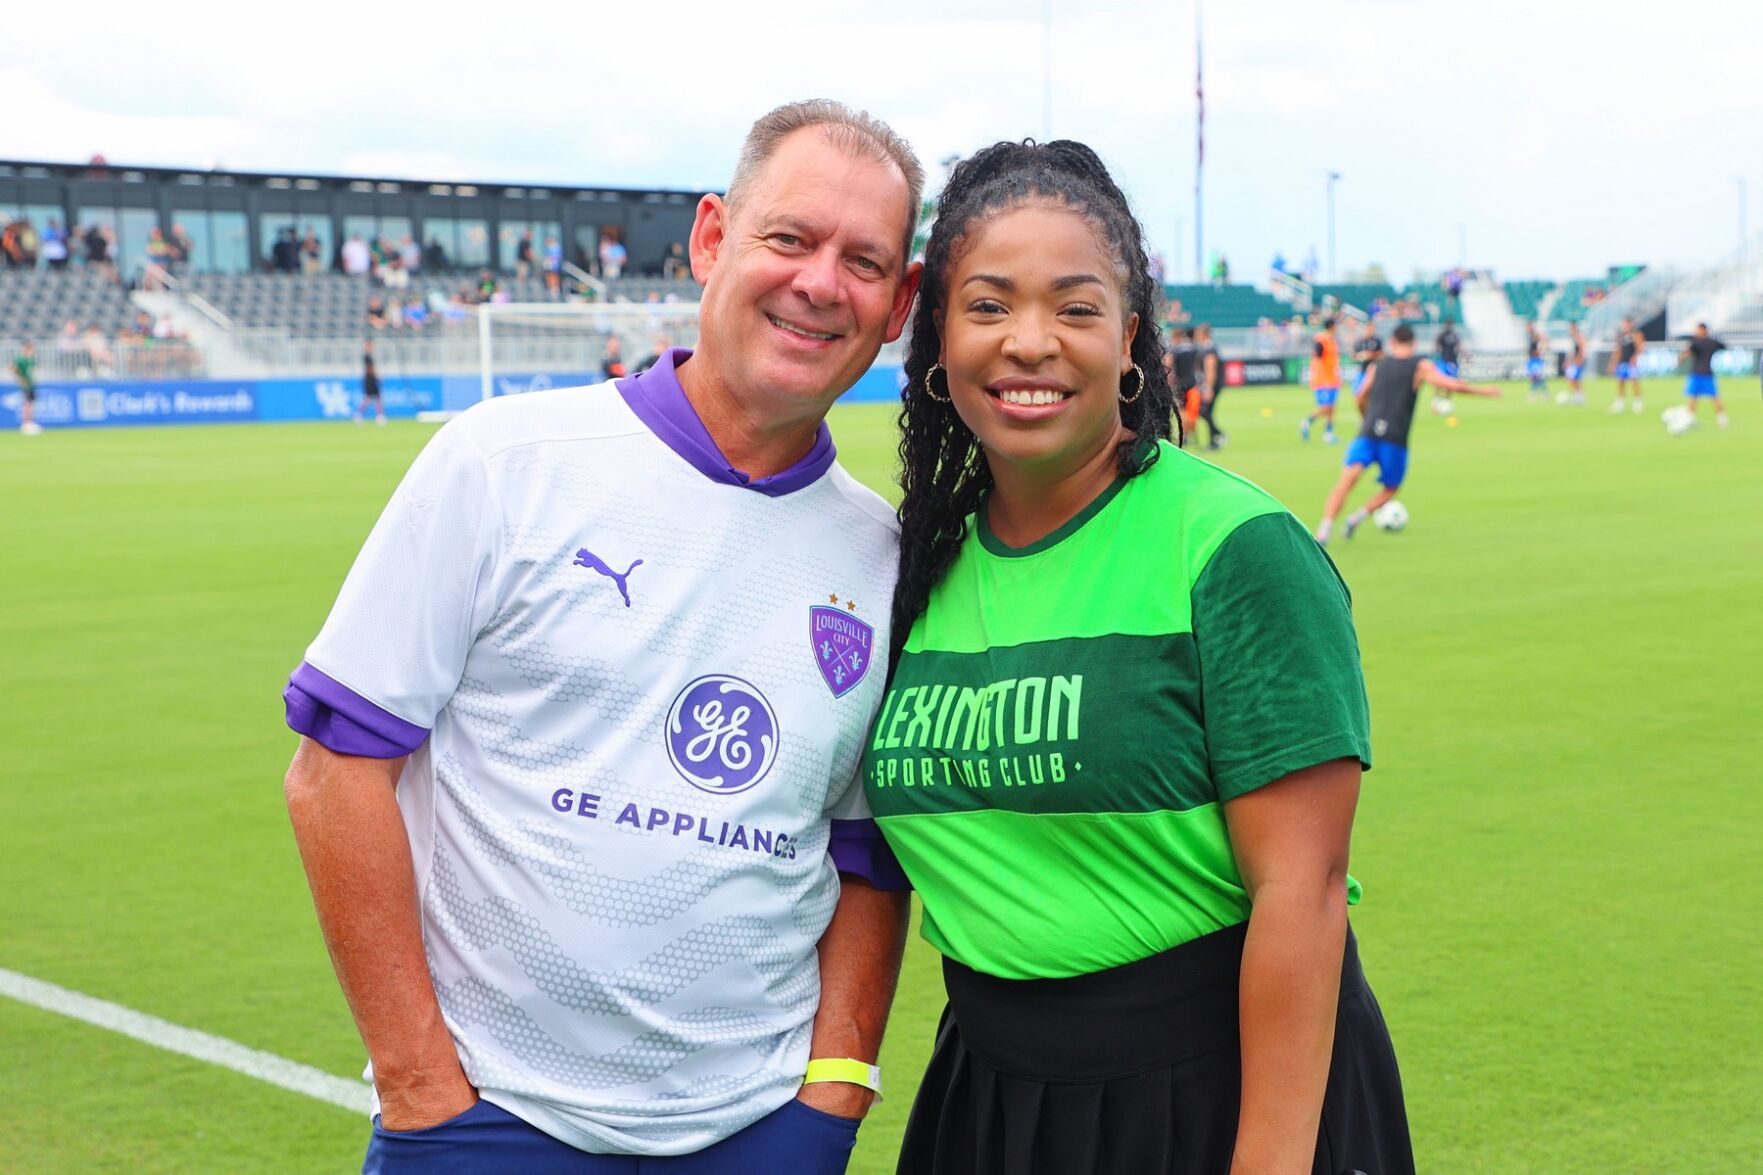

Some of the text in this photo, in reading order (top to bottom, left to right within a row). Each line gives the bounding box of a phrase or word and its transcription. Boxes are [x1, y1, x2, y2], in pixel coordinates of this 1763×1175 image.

[107, 388, 253, 415] Clark's Rewards
[816, 614, 868, 649] LOUISVILLE
[833, 632, 850, 647] CITY
[872, 674, 1083, 752] LEXINGTON
[875, 752, 1066, 789] SPORTING CLUB
[551, 787, 602, 818] GE
